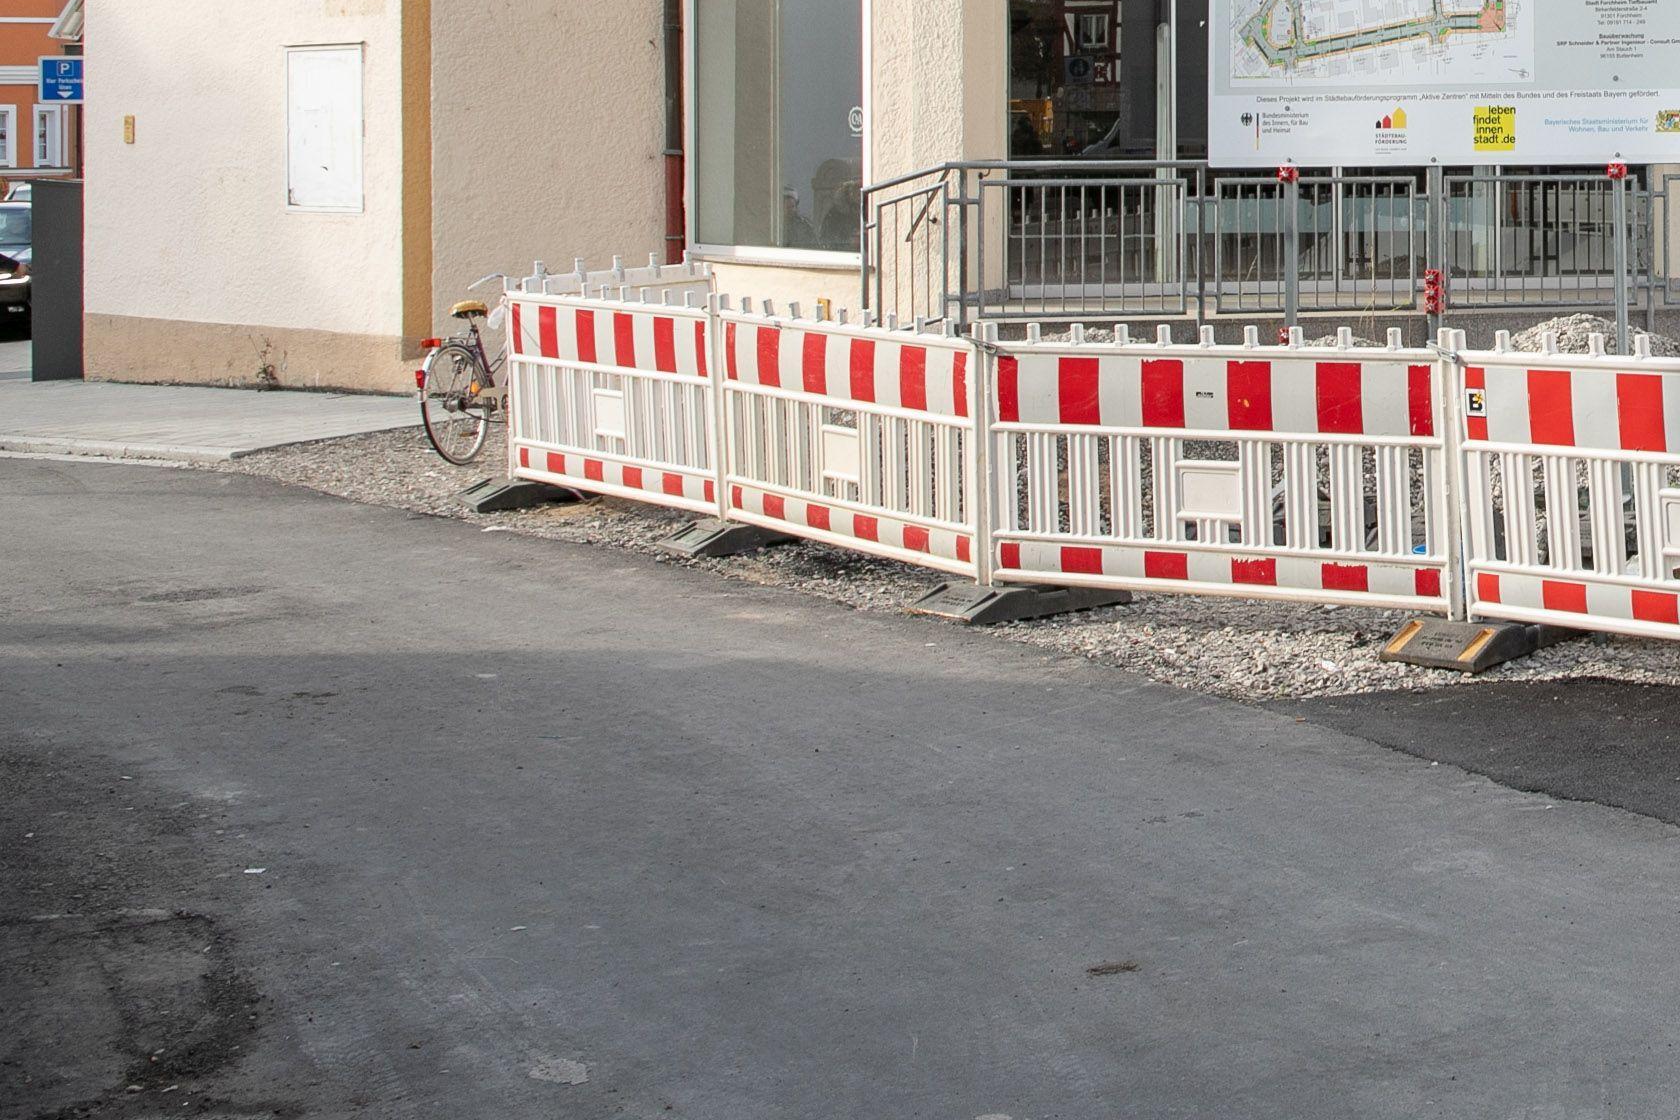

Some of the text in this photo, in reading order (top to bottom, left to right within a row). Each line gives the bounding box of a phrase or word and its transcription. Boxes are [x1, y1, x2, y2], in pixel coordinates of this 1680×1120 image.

[60, 63, 70, 75] P
[1256, 95, 1278, 103] Dieses
[1279, 95, 1300, 103] Projekt
[1316, 94, 1323, 102] im
[1542, 91, 1554, 99] und
[1603, 91, 1627, 99] Bayern
[1488, 105, 1516, 115] leben
[1473, 115, 1501, 125] findet
[1544, 118, 1581, 126] Bayerisches
[1476, 125, 1503, 134] innen
[1473, 134, 1516, 144] stadt .de
